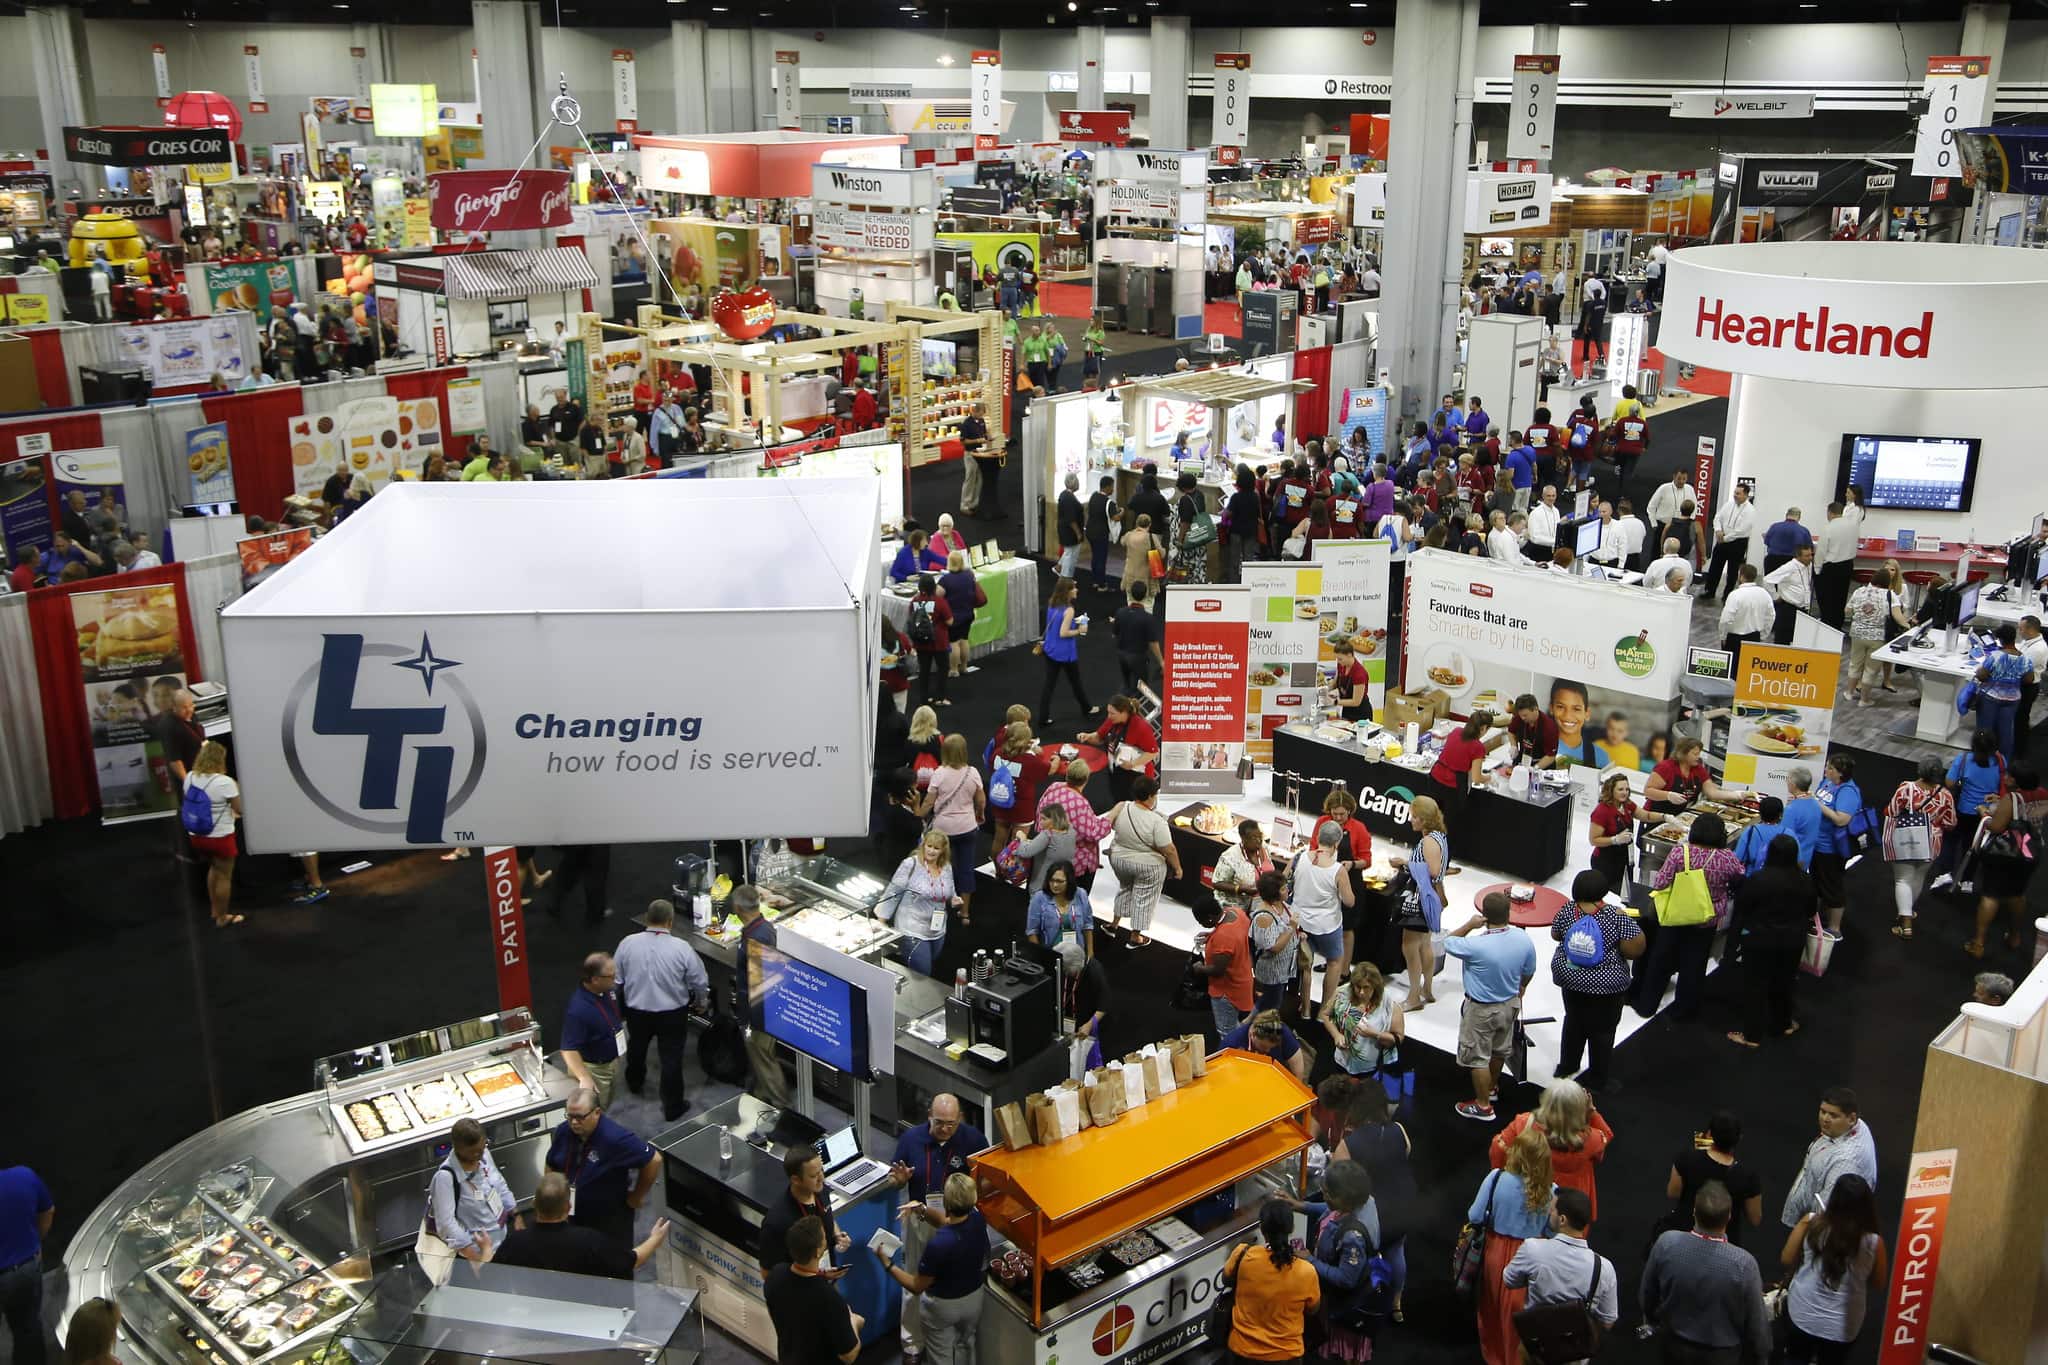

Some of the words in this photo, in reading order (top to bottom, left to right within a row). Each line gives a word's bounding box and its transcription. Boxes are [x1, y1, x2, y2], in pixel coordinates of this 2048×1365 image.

[1226, 79, 1235, 126] 800
[1526, 83, 1539, 136] 900
[1736, 102, 1788, 111] WELBILT
[1938, 84, 1958, 167] 1000
[77, 137, 96, 153] CRES
[97, 139, 112, 156] COR
[148, 140, 187, 156] CRES
[189, 139, 222, 154] COR
[979, 139, 993, 147] 700
[1222, 150, 1234, 160] 800
[831, 172, 882, 193] Winston
[1763, 175, 1814, 186] VULCAN
[1868, 175, 1893, 187] VULCAN
[1111, 187, 1149, 200] HOLDING
[1501, 184, 1533, 197] HOBART
[455, 180, 522, 226] Giorgio
[865, 224, 878, 234] NO
[880, 225, 910, 236] HOOD
[865, 236, 910, 249] NEEDED
[1695, 296, 1934, 359] Heartland
[1003, 351, 1012, 396] PATRON
[1355, 397, 1373, 408] Dole
[1696, 459, 1710, 517] PATRON
[1430, 598, 1481, 621] Favorites
[1483, 610, 1506, 626] that
[1508, 617, 1528, 630] are
[1249, 628, 1273, 639] New
[1429, 614, 1484, 641] Smarter
[1489, 625, 1507, 649] by
[1512, 632, 1535, 653] the
[1540, 637, 1597, 671] Serving
[1249, 641, 1304, 656] Products
[1615, 646, 1655, 660] SMARTER
[1619, 661, 1651, 671] SERVING
[1695, 665, 1722, 677] 2017
[1698, 659, 1725, 668] FRIEND
[1751, 656, 1792, 673] Power
[1794, 662, 1809, 674] of
[1749, 673, 1817, 699] Protein
[515, 712, 703, 743] Changing
[547, 751, 605, 774] how
[616, 749, 679, 773] food
[689, 749, 713, 770] is
[723, 746, 822, 769] served.
[1359, 786, 1412, 825] Carg
[494, 857, 520, 966] PATRON
[1910, 1180, 1950, 1190] PATRON
[1894, 1206, 1937, 1345] PATRON
[1162, 1330, 1184, 1347] way
[1186, 1325, 1198, 1337] to
